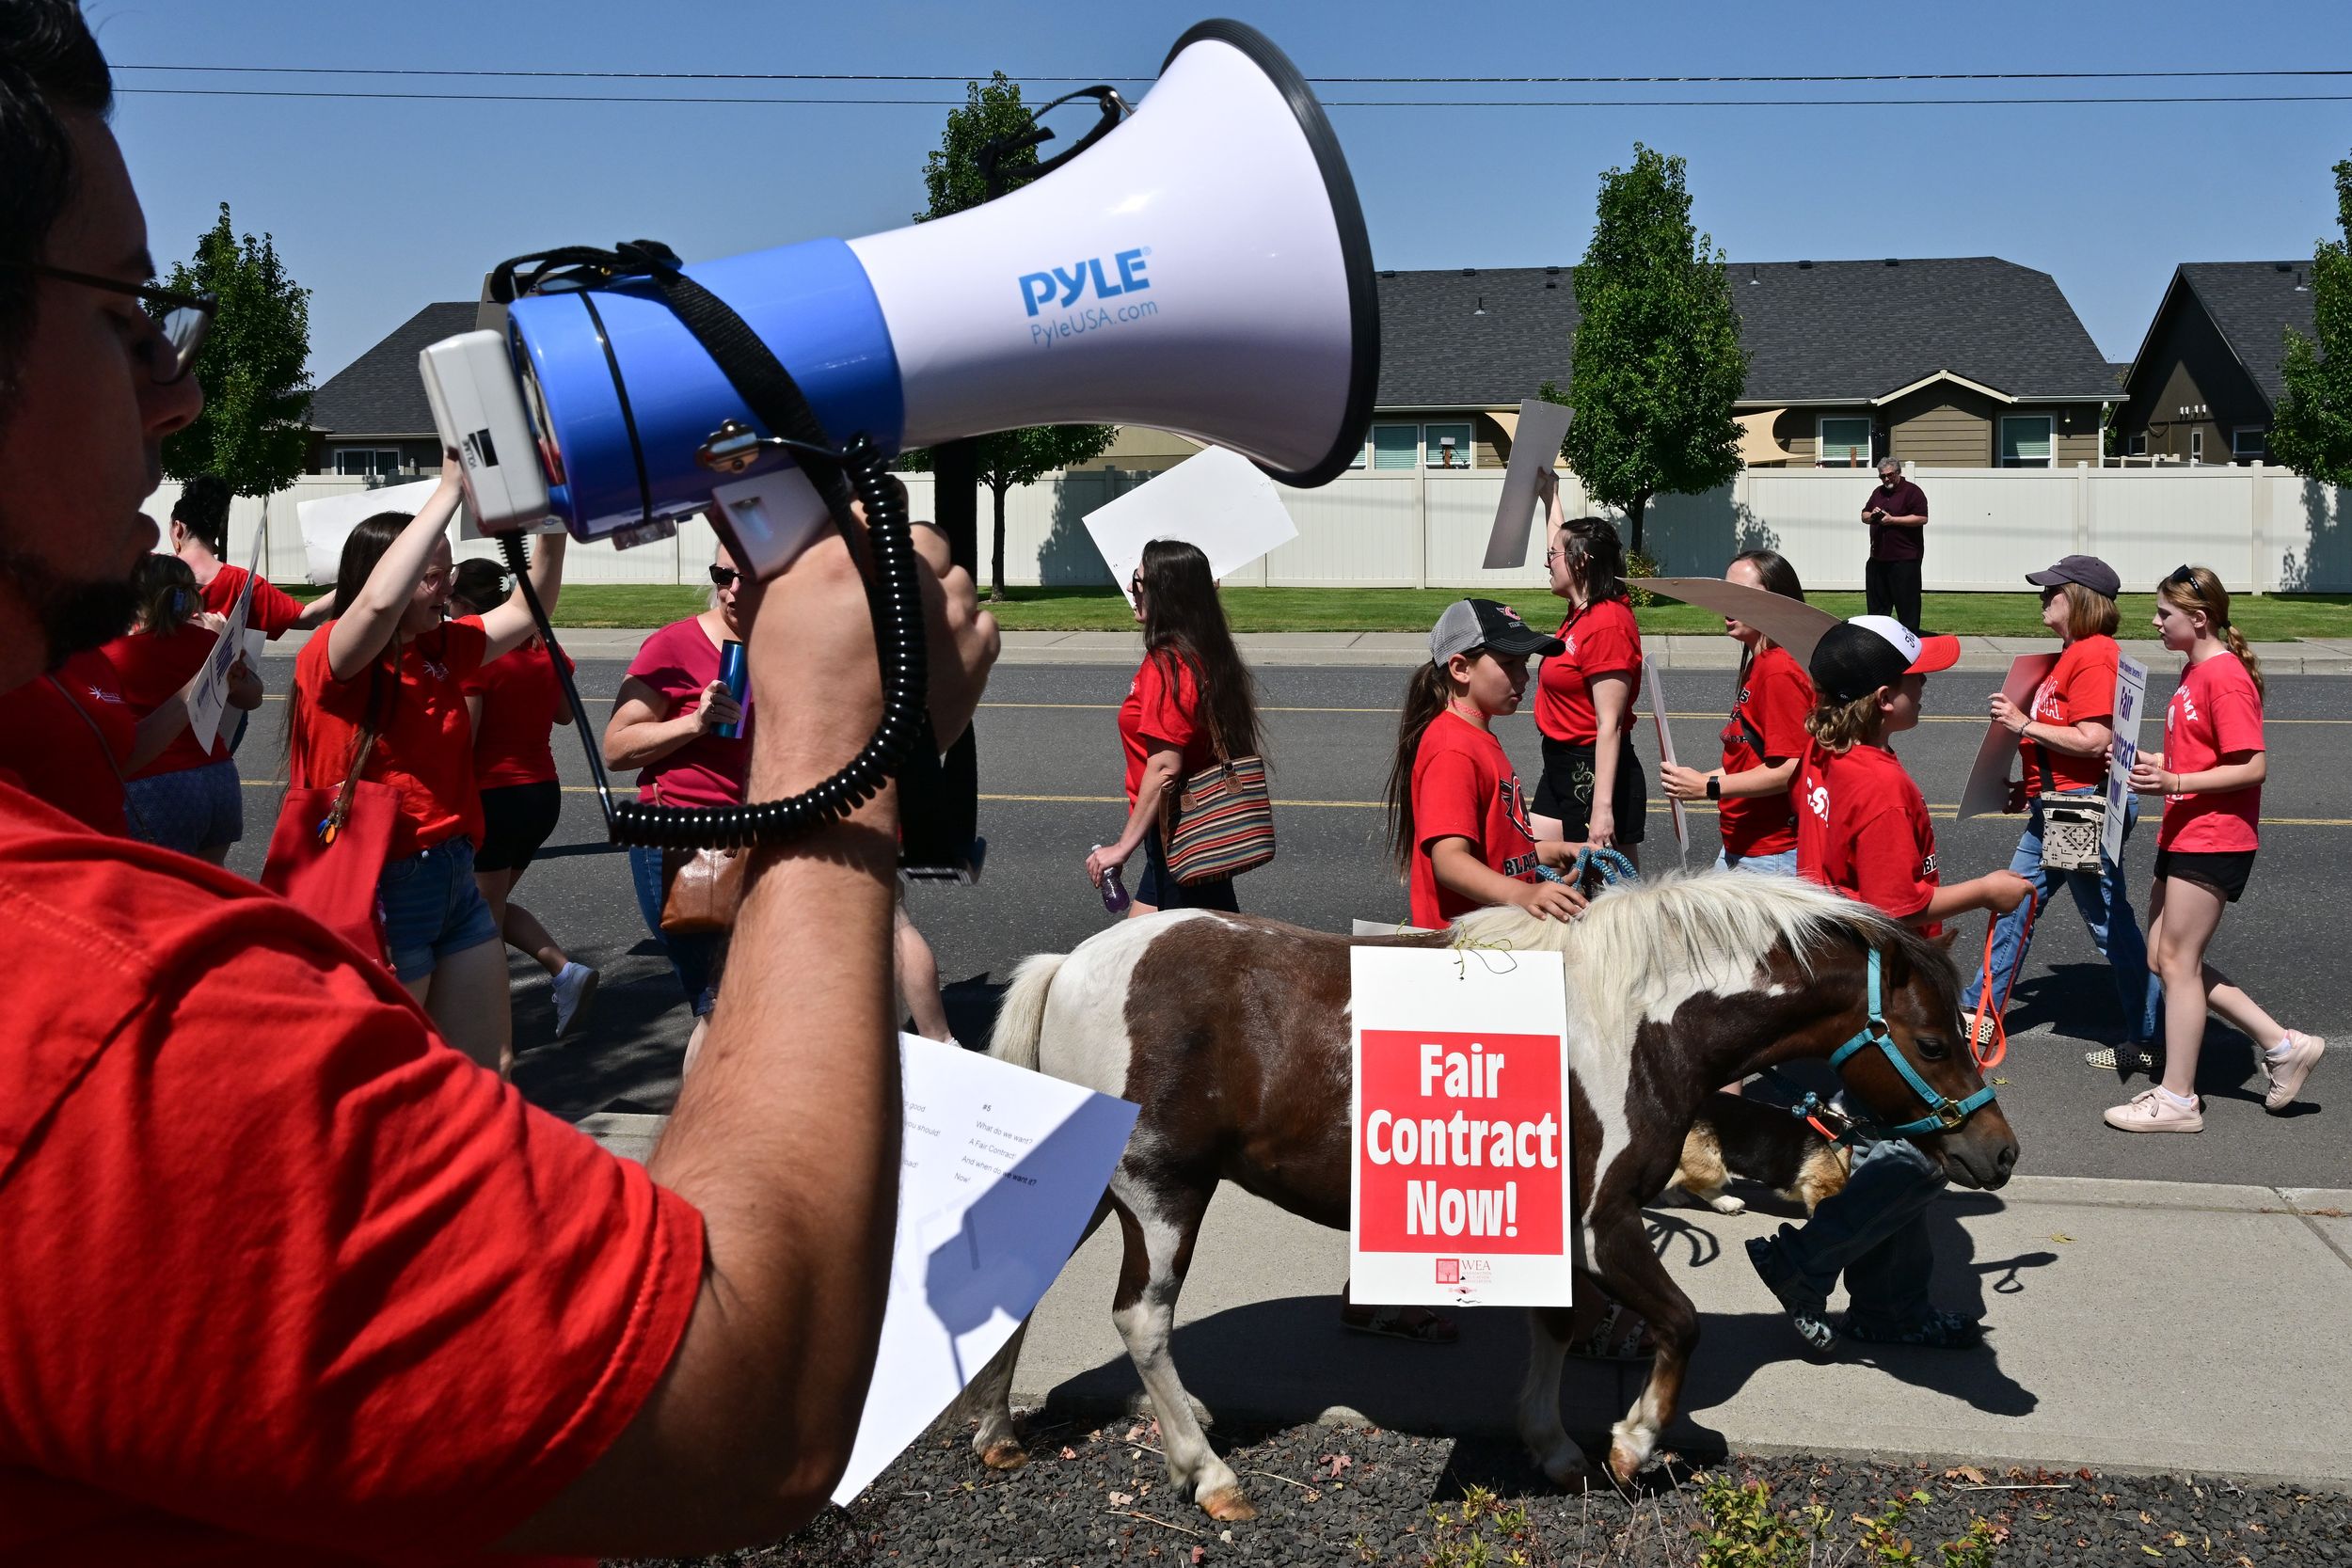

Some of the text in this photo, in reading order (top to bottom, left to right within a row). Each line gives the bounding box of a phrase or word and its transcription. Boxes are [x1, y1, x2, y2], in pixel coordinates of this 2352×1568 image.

[1019, 248, 1150, 317] PYLE
[1031, 301, 1158, 348] PyleUSA.com
[2119, 686, 2134, 721] Fair
[1420, 1043, 1504, 1099] Fair
[982, 1103, 992, 1112] #5
[975, 1139, 987, 1148] Fair
[976, 1120, 993, 1132] What
[1014, 1134, 1033, 1145] want?
[1366, 1109, 1557, 1169] Contract
[961, 1155, 975, 1165] And
[976, 1161, 992, 1171] when
[993, 1166, 1001, 1175] do
[1012, 1174, 1027, 1184] want
[1406, 1180, 1518, 1237] Now!
[1461, 1259, 1491, 1271] WEA
